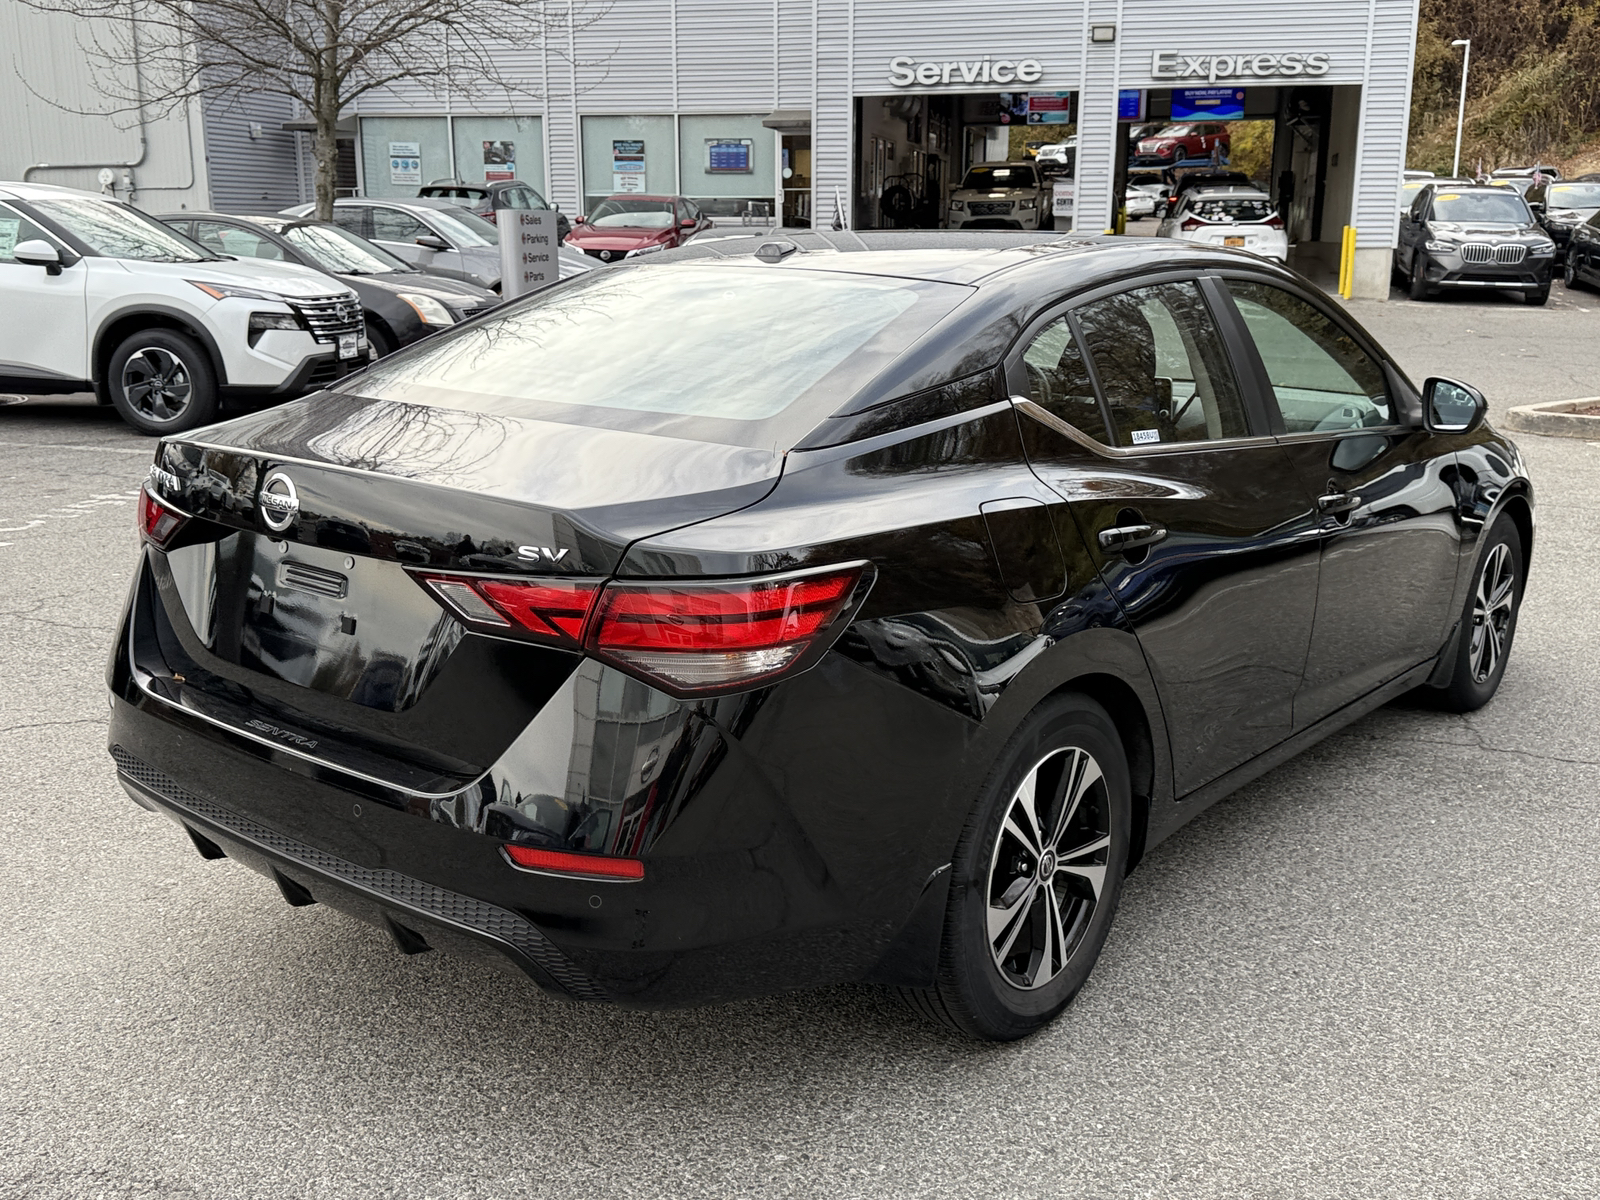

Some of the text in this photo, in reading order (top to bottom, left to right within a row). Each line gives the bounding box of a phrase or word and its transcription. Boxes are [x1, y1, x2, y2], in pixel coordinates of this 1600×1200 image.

[887, 49, 1330, 87] Service Express
[525, 214, 542, 225] Sales
[526, 233, 549, 246] Parking
[527, 252, 550, 263] Service
[529, 271, 545, 282] Parts
[517, 545, 569, 562] SV
[245, 719, 318, 749] SENTRA
